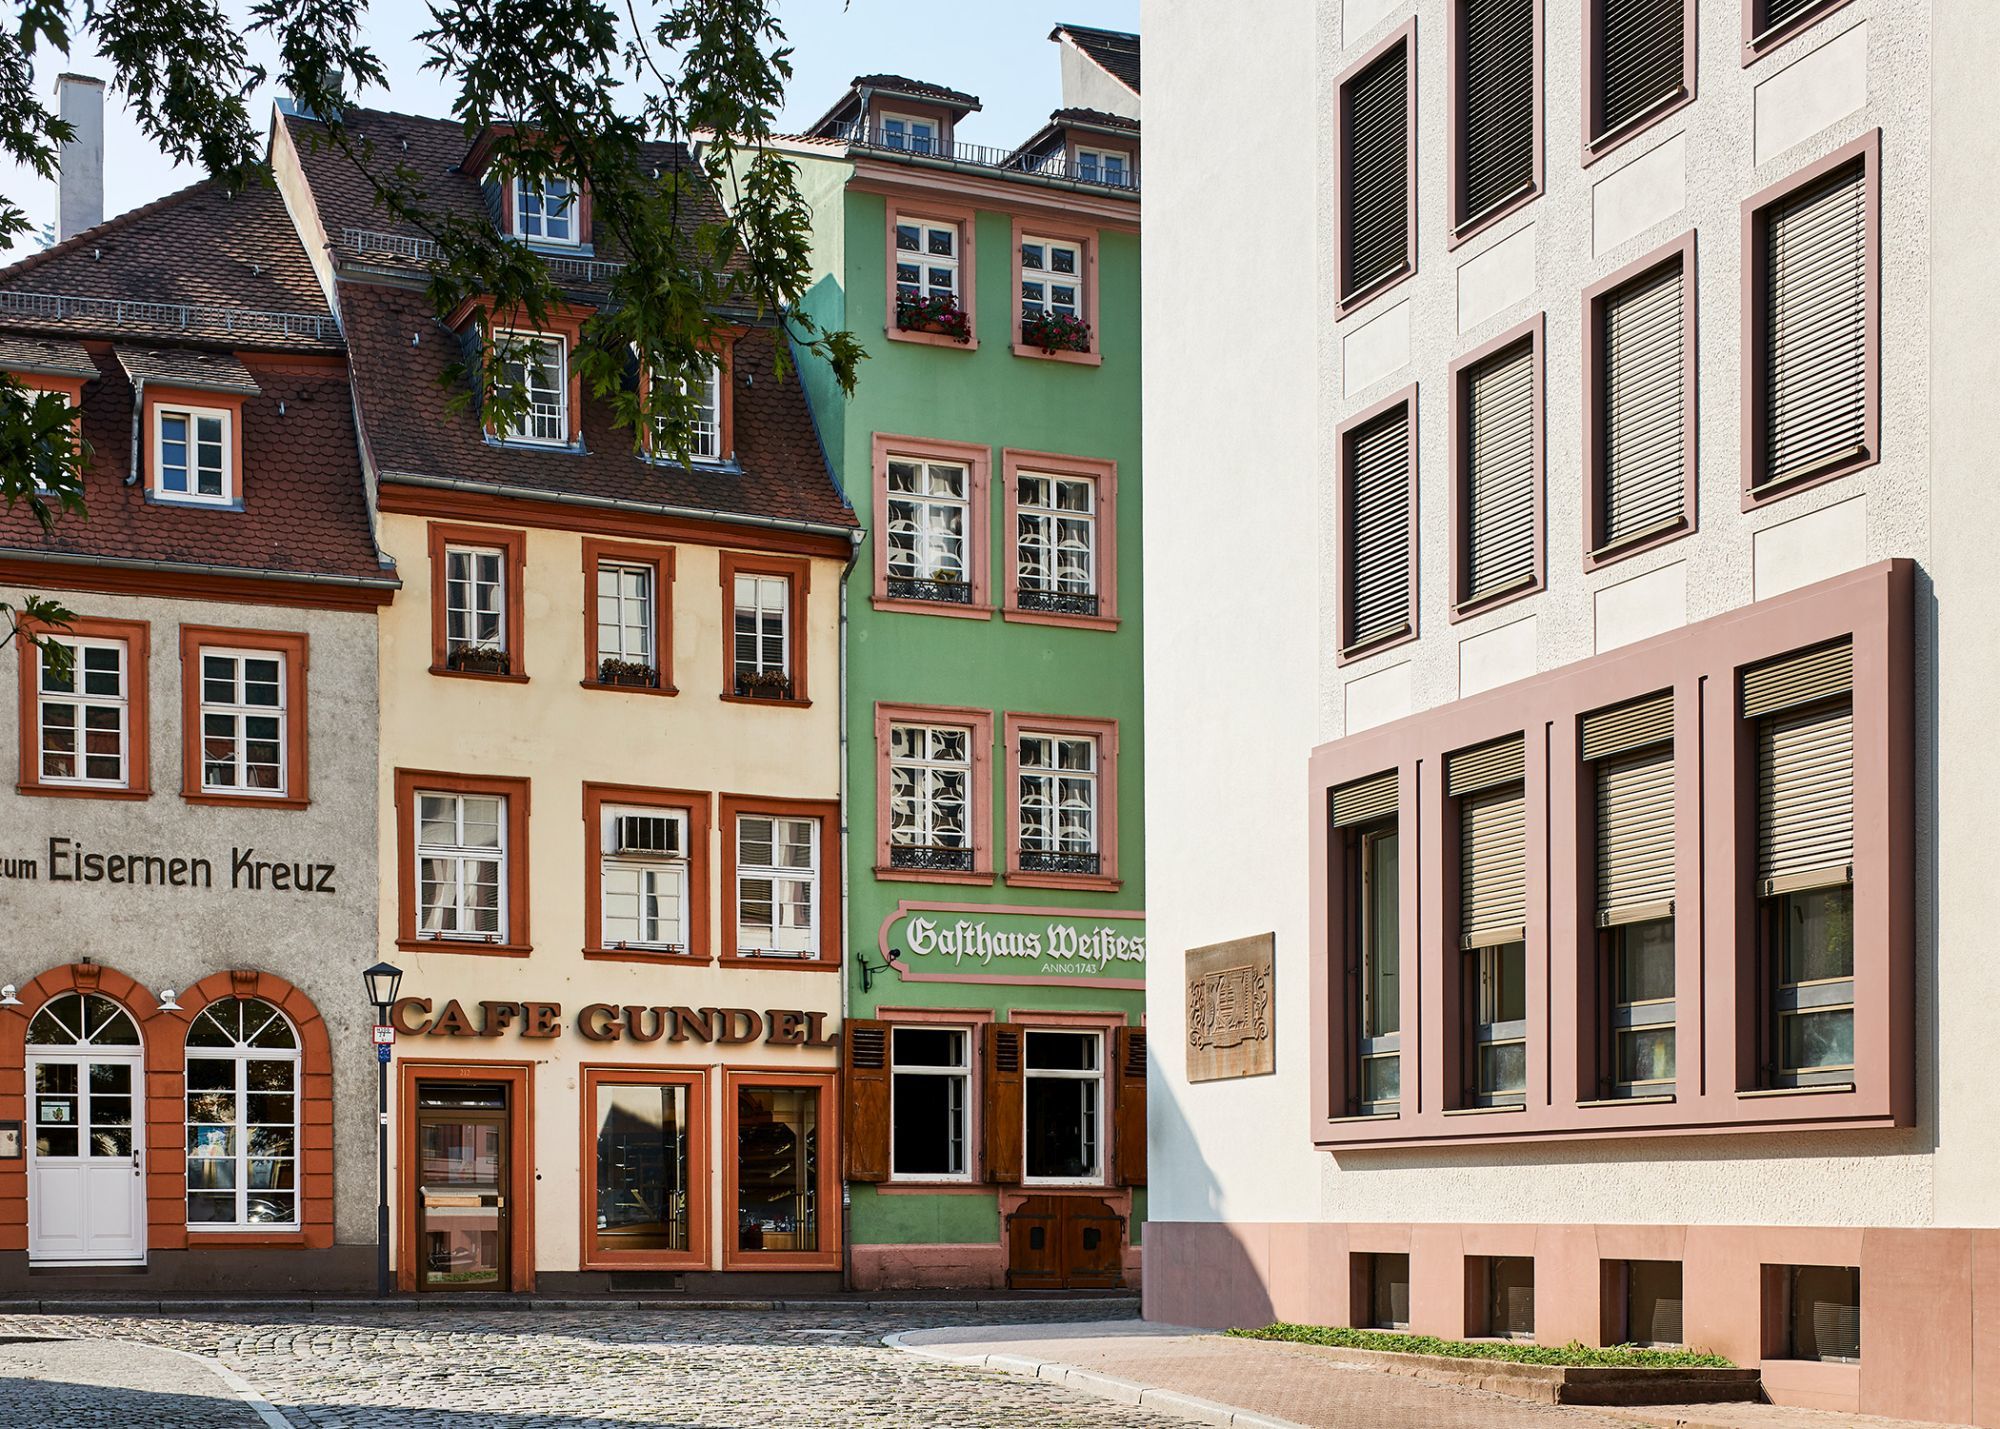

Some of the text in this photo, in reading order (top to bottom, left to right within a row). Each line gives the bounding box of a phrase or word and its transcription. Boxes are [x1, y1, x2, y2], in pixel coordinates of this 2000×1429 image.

[49, 836, 212, 888] Eisernen
[231, 846, 336, 894] Kreuz
[1041, 962, 1098, 975] ANNO 1743
[390, 997, 841, 1049] CAFE GUNDEL
